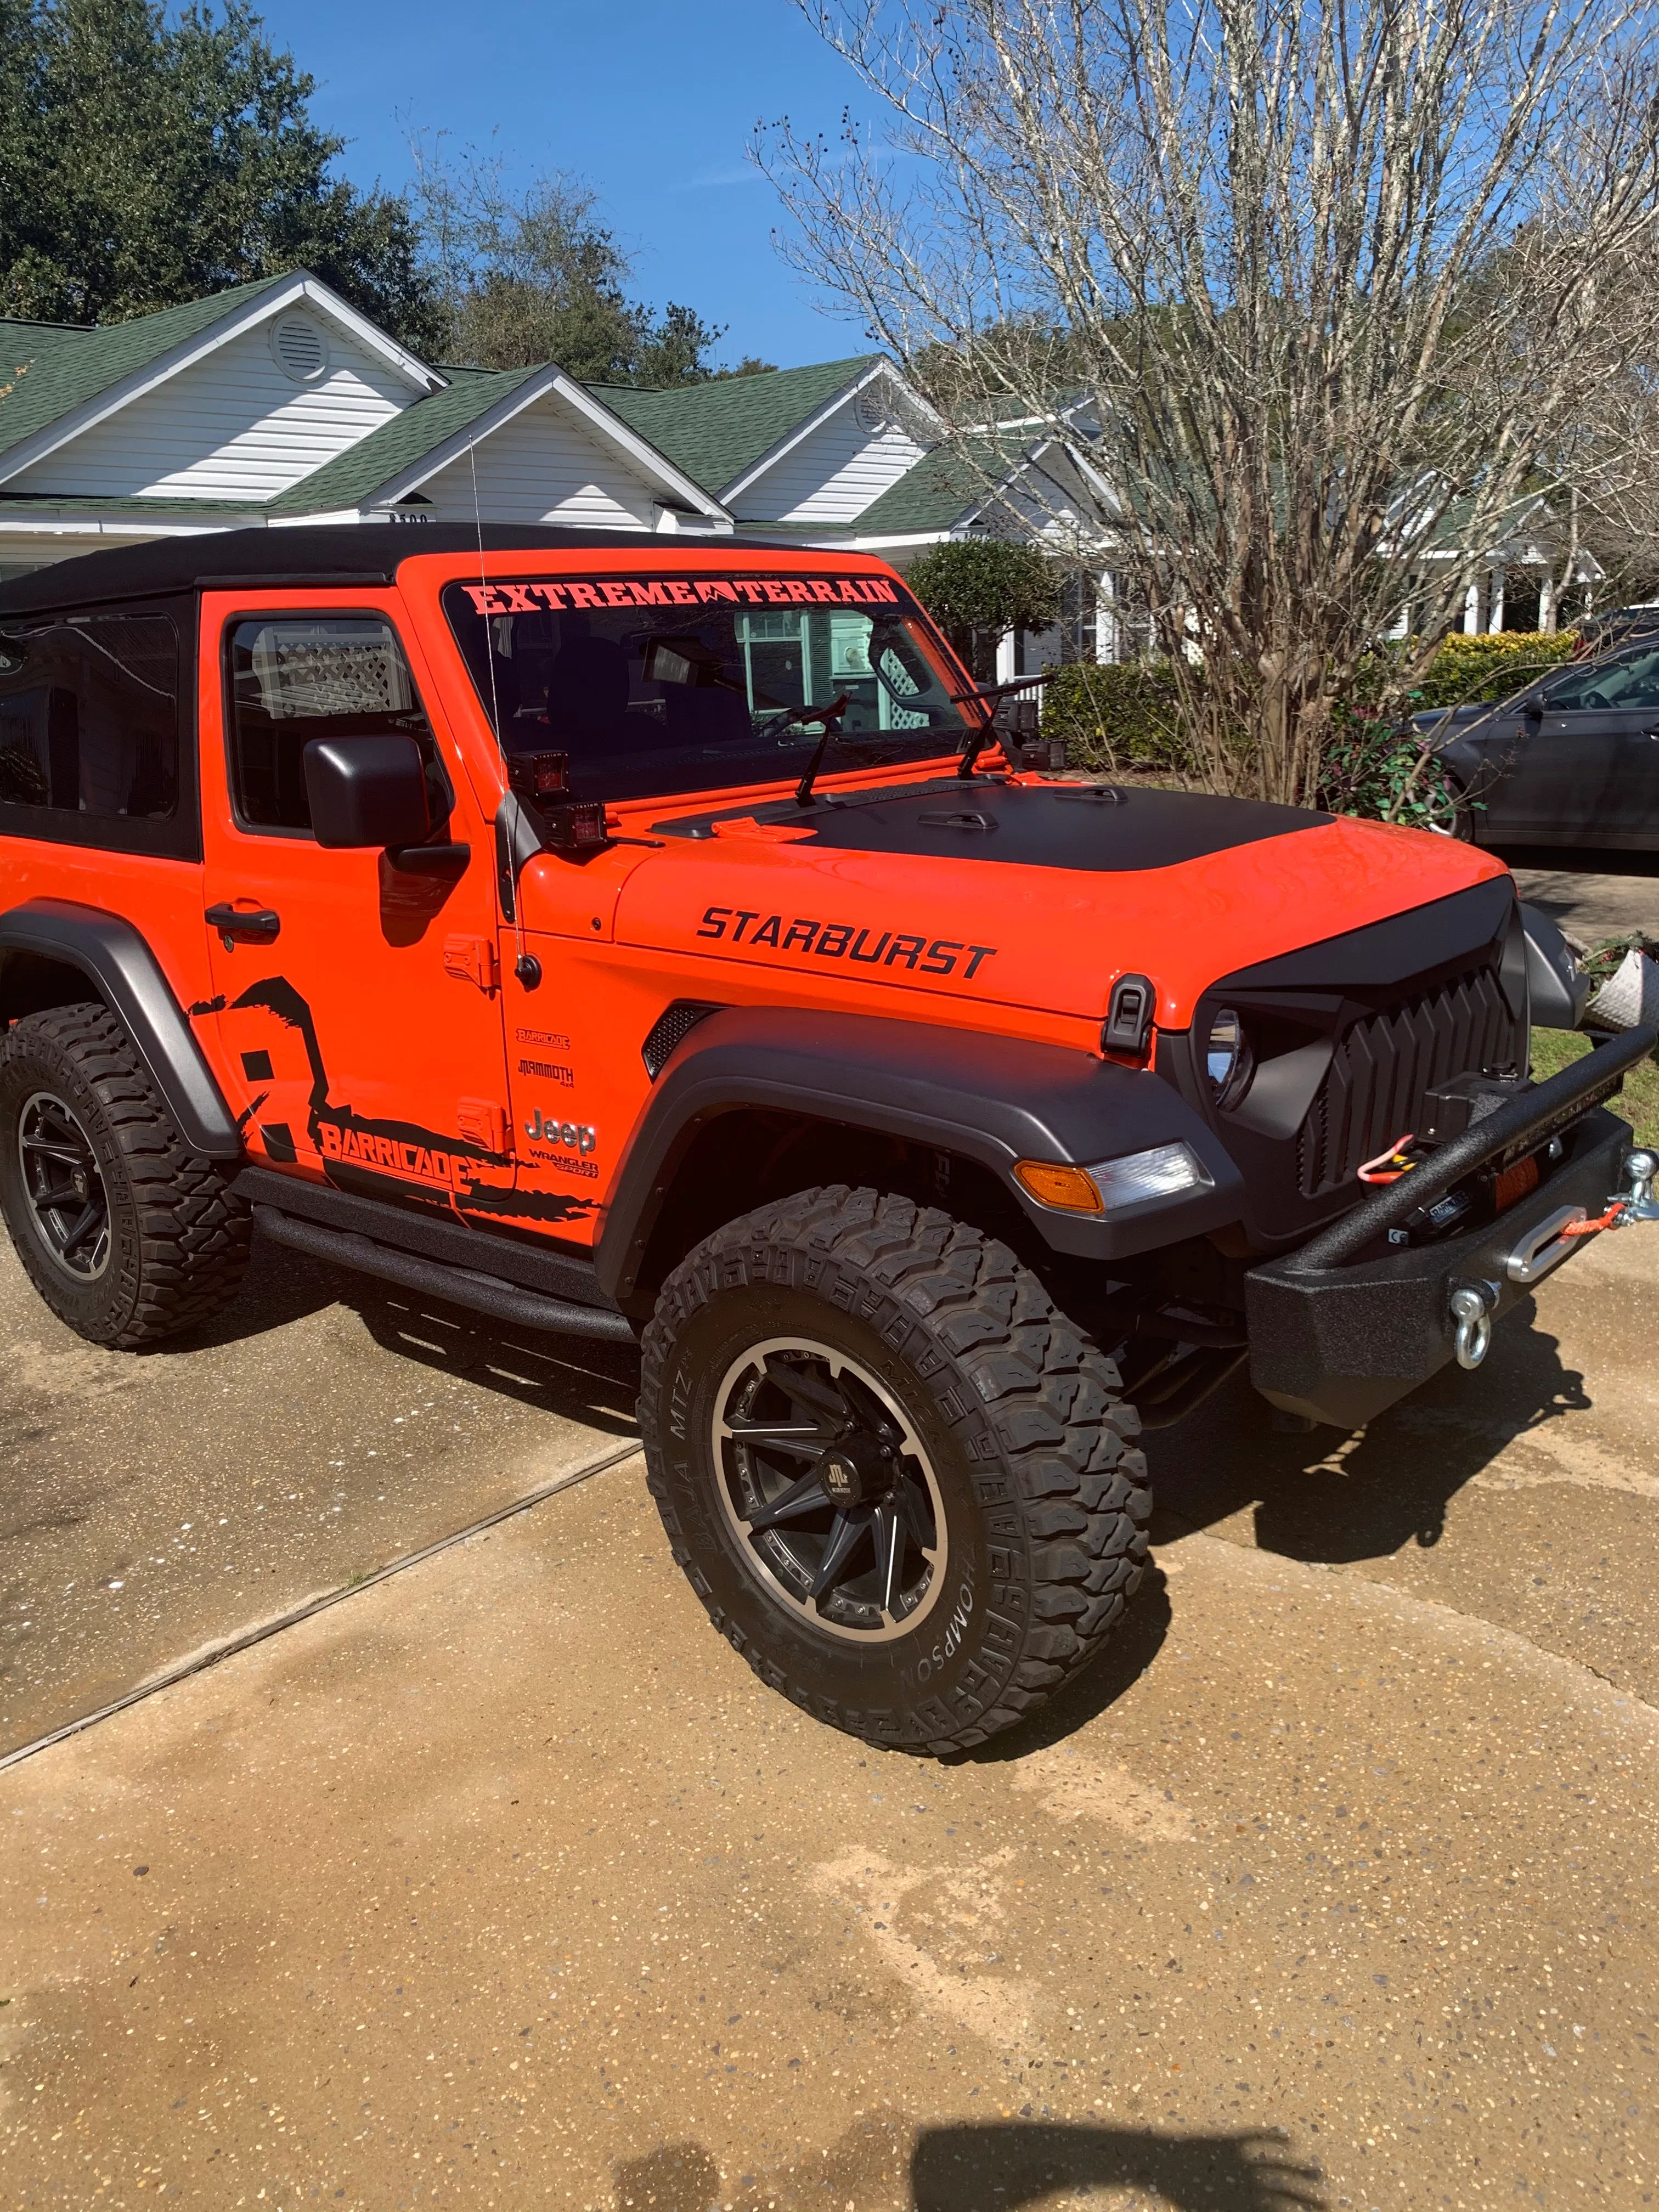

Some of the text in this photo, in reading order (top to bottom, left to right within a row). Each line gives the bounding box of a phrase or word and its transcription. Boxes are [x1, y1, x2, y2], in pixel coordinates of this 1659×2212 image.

[461, 580, 899, 615] EXTREME TERRAIN
[696, 906, 999, 980] STARBURST
[516, 1029, 570, 1049] BARRICADE
[518, 1059, 574, 1082] MAMMOTH
[524, 1109, 596, 1156] Jeep
[317, 1121, 473, 1196] BARRICADE
[529, 1148, 599, 1172] WRANGLER
[555, 1164, 599, 1178] SPORT
[669, 1369, 693, 1441] MTZ
[673, 1459, 719, 1554] BAJA
